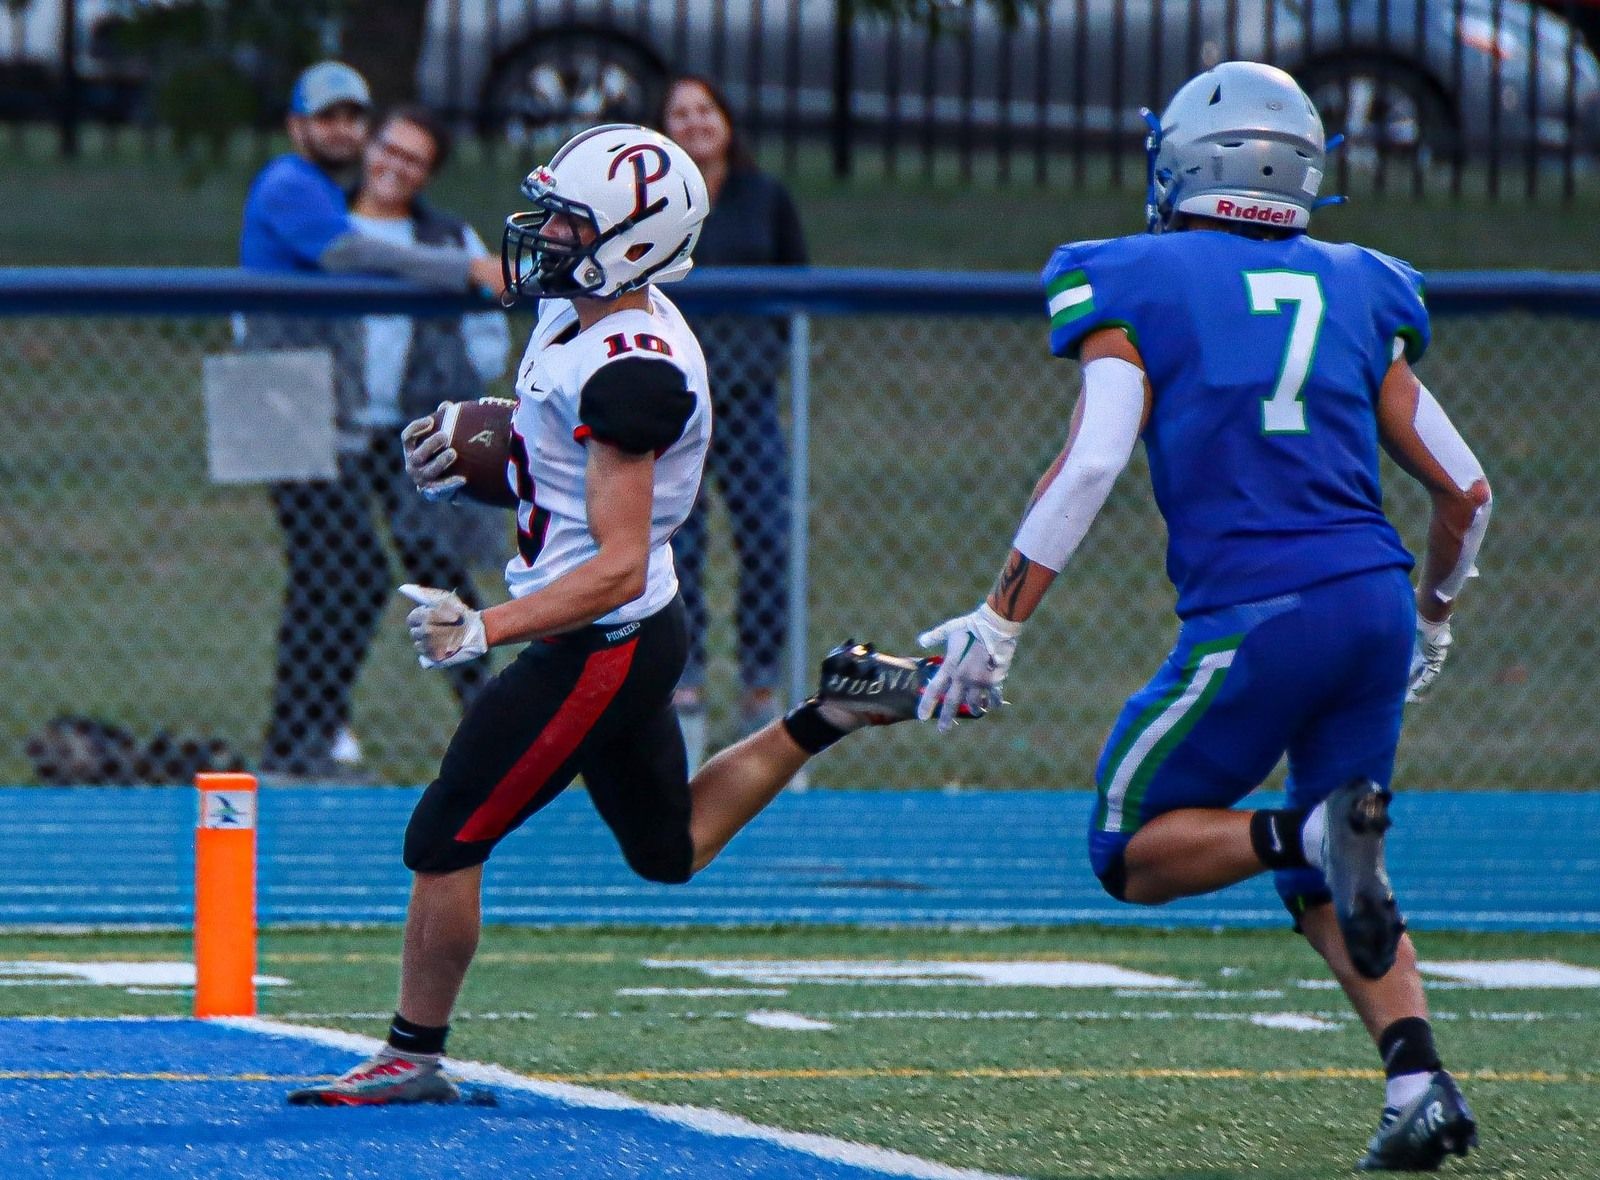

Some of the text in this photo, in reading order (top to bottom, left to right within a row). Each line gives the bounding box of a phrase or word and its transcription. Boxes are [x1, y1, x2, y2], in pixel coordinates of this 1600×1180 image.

[608, 143, 672, 218] P
[1216, 199, 1297, 224] Riddell
[603, 332, 673, 358] 10
[1243, 269, 1326, 435] 7
